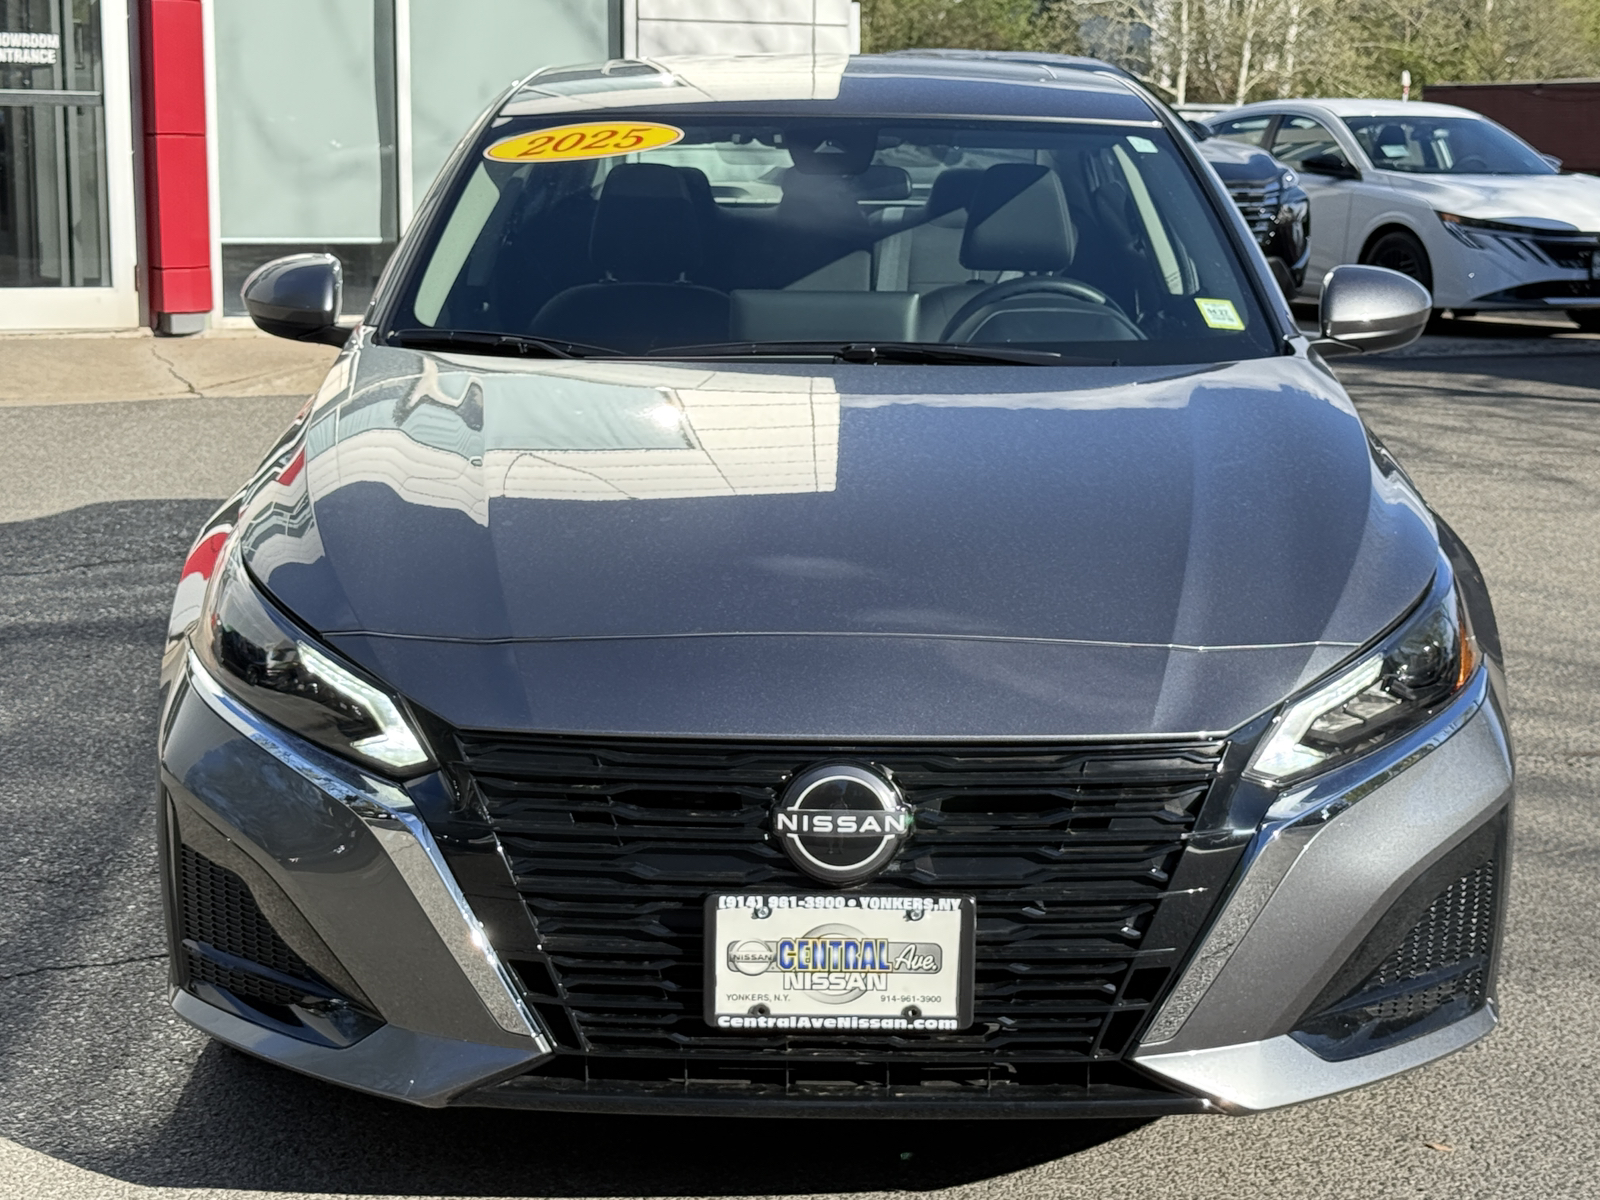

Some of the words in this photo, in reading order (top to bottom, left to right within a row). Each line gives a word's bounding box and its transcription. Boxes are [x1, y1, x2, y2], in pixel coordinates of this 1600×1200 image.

[0, 32, 60, 48] OWROOM
[517, 128, 652, 157] 2025
[777, 813, 905, 833] NISSAN
[732, 953, 772, 961] NISSAN
[777, 937, 893, 973] CENTRAL
[894, 943, 939, 971] Ave.
[783, 971, 887, 991] NISSAN
[726, 993, 772, 1002] YONKERS,
[774, 994, 791, 1002] N.Y.
[880, 995, 942, 1003] 914-961-3900
[717, 1015, 958, 1030] CentralAveNissan.com
